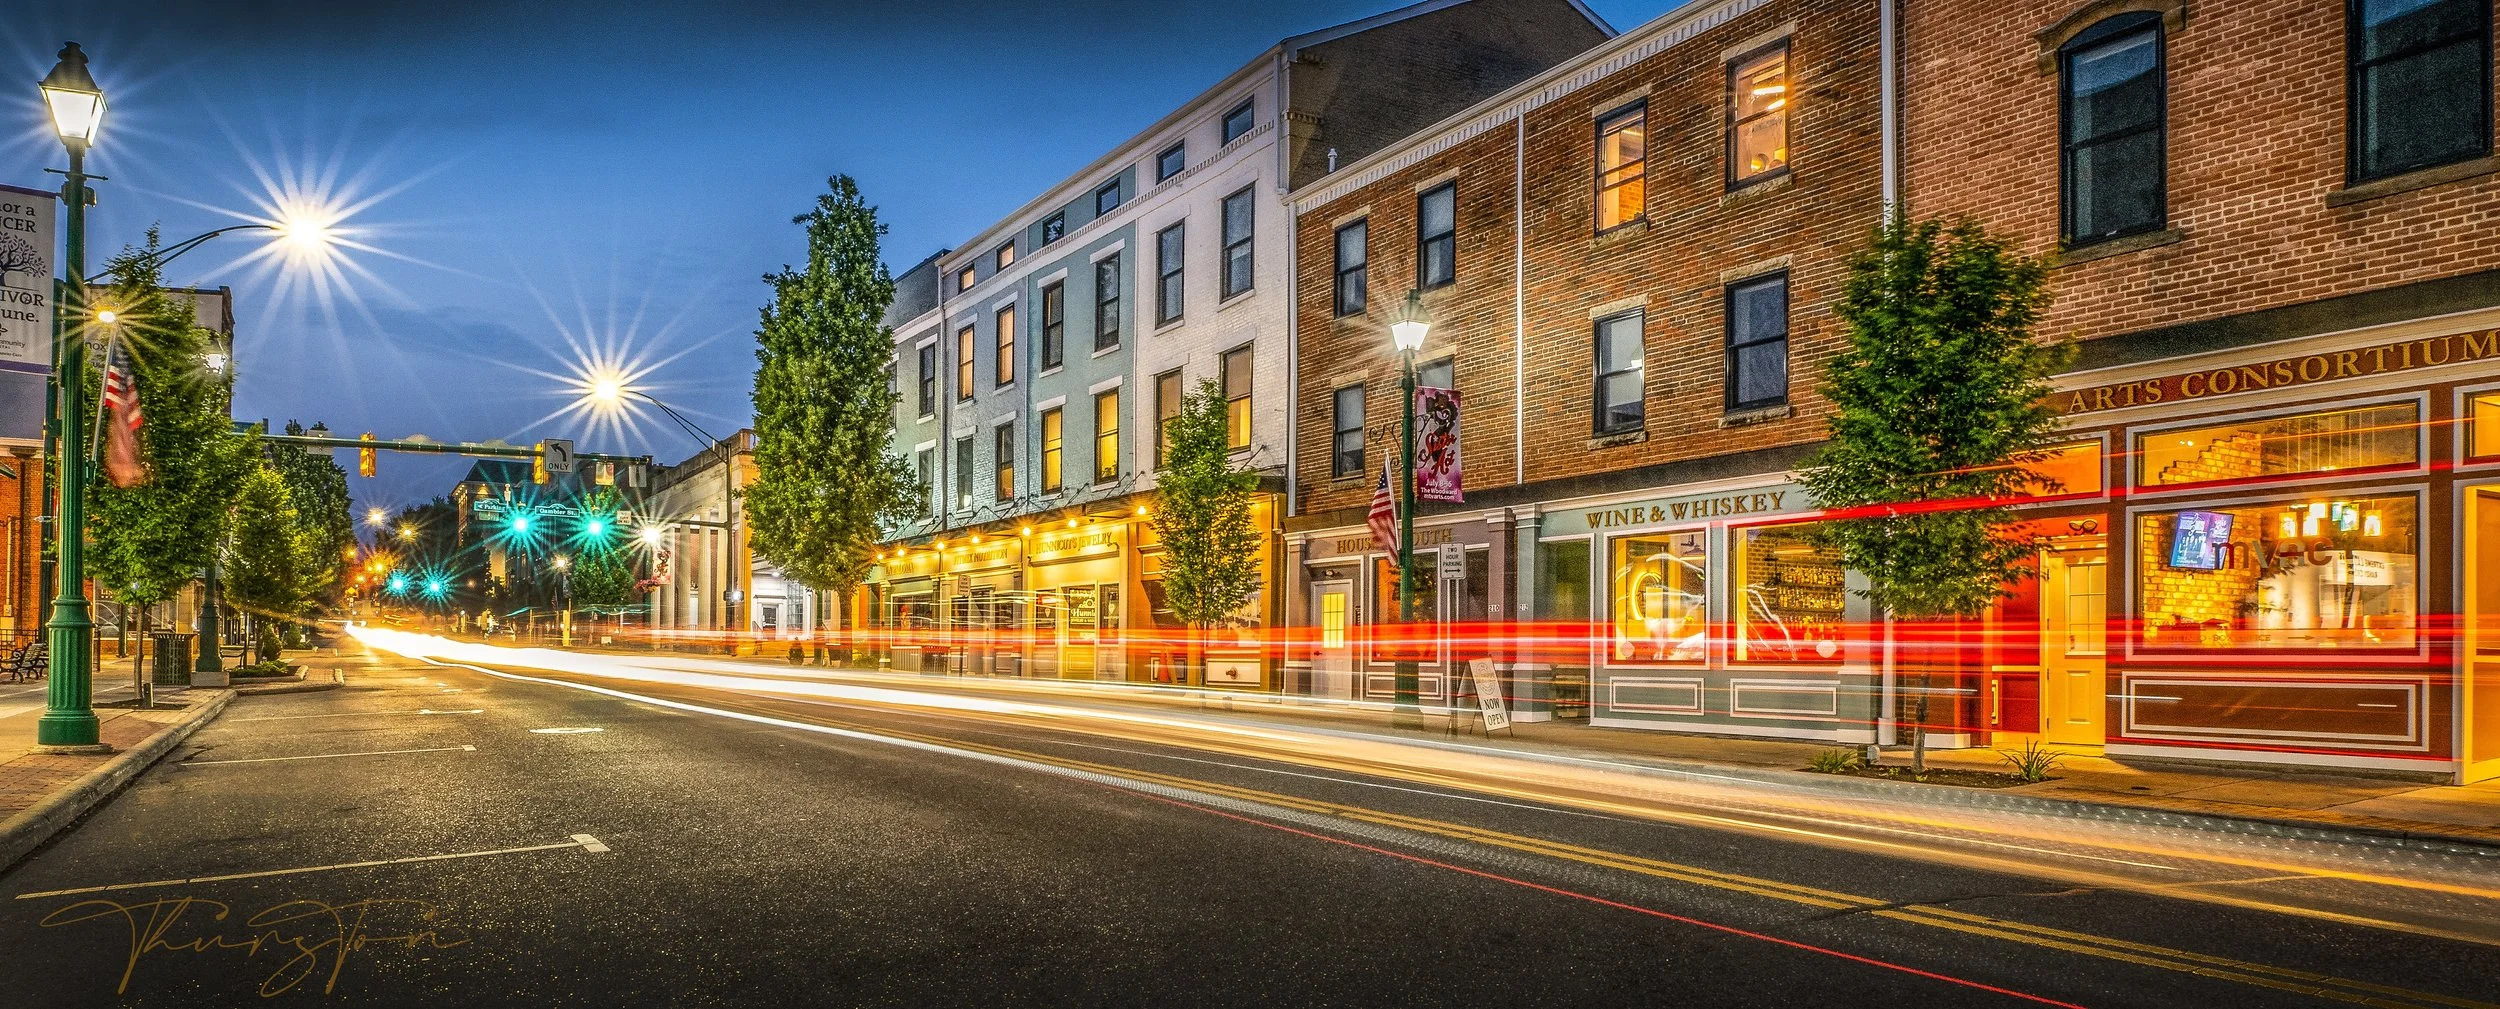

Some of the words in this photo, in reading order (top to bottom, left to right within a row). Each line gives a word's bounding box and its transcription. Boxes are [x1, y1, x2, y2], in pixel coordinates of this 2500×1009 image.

[0, 202, 21, 216] or
[26, 206, 36, 217] a
[0, 216, 37, 233] CER
[2068, 378, 2164, 416] ARTS
[2181, 328, 2500, 399] CONSORTIUM
[548, 462, 570, 471] ONLY
[1426, 479, 1439, 488] July
[484, 504, 507, 512] Parking
[1586, 506, 1645, 530] WINE
[1649, 505, 1666, 523] &
[1669, 490, 1787, 521] WHISKEY
[1077, 531, 1112, 552] JEWELRY
[1336, 537, 1374, 554] HOUS
[1483, 697, 1500, 711] NOW
[1487, 712, 1506, 726] OPEN
